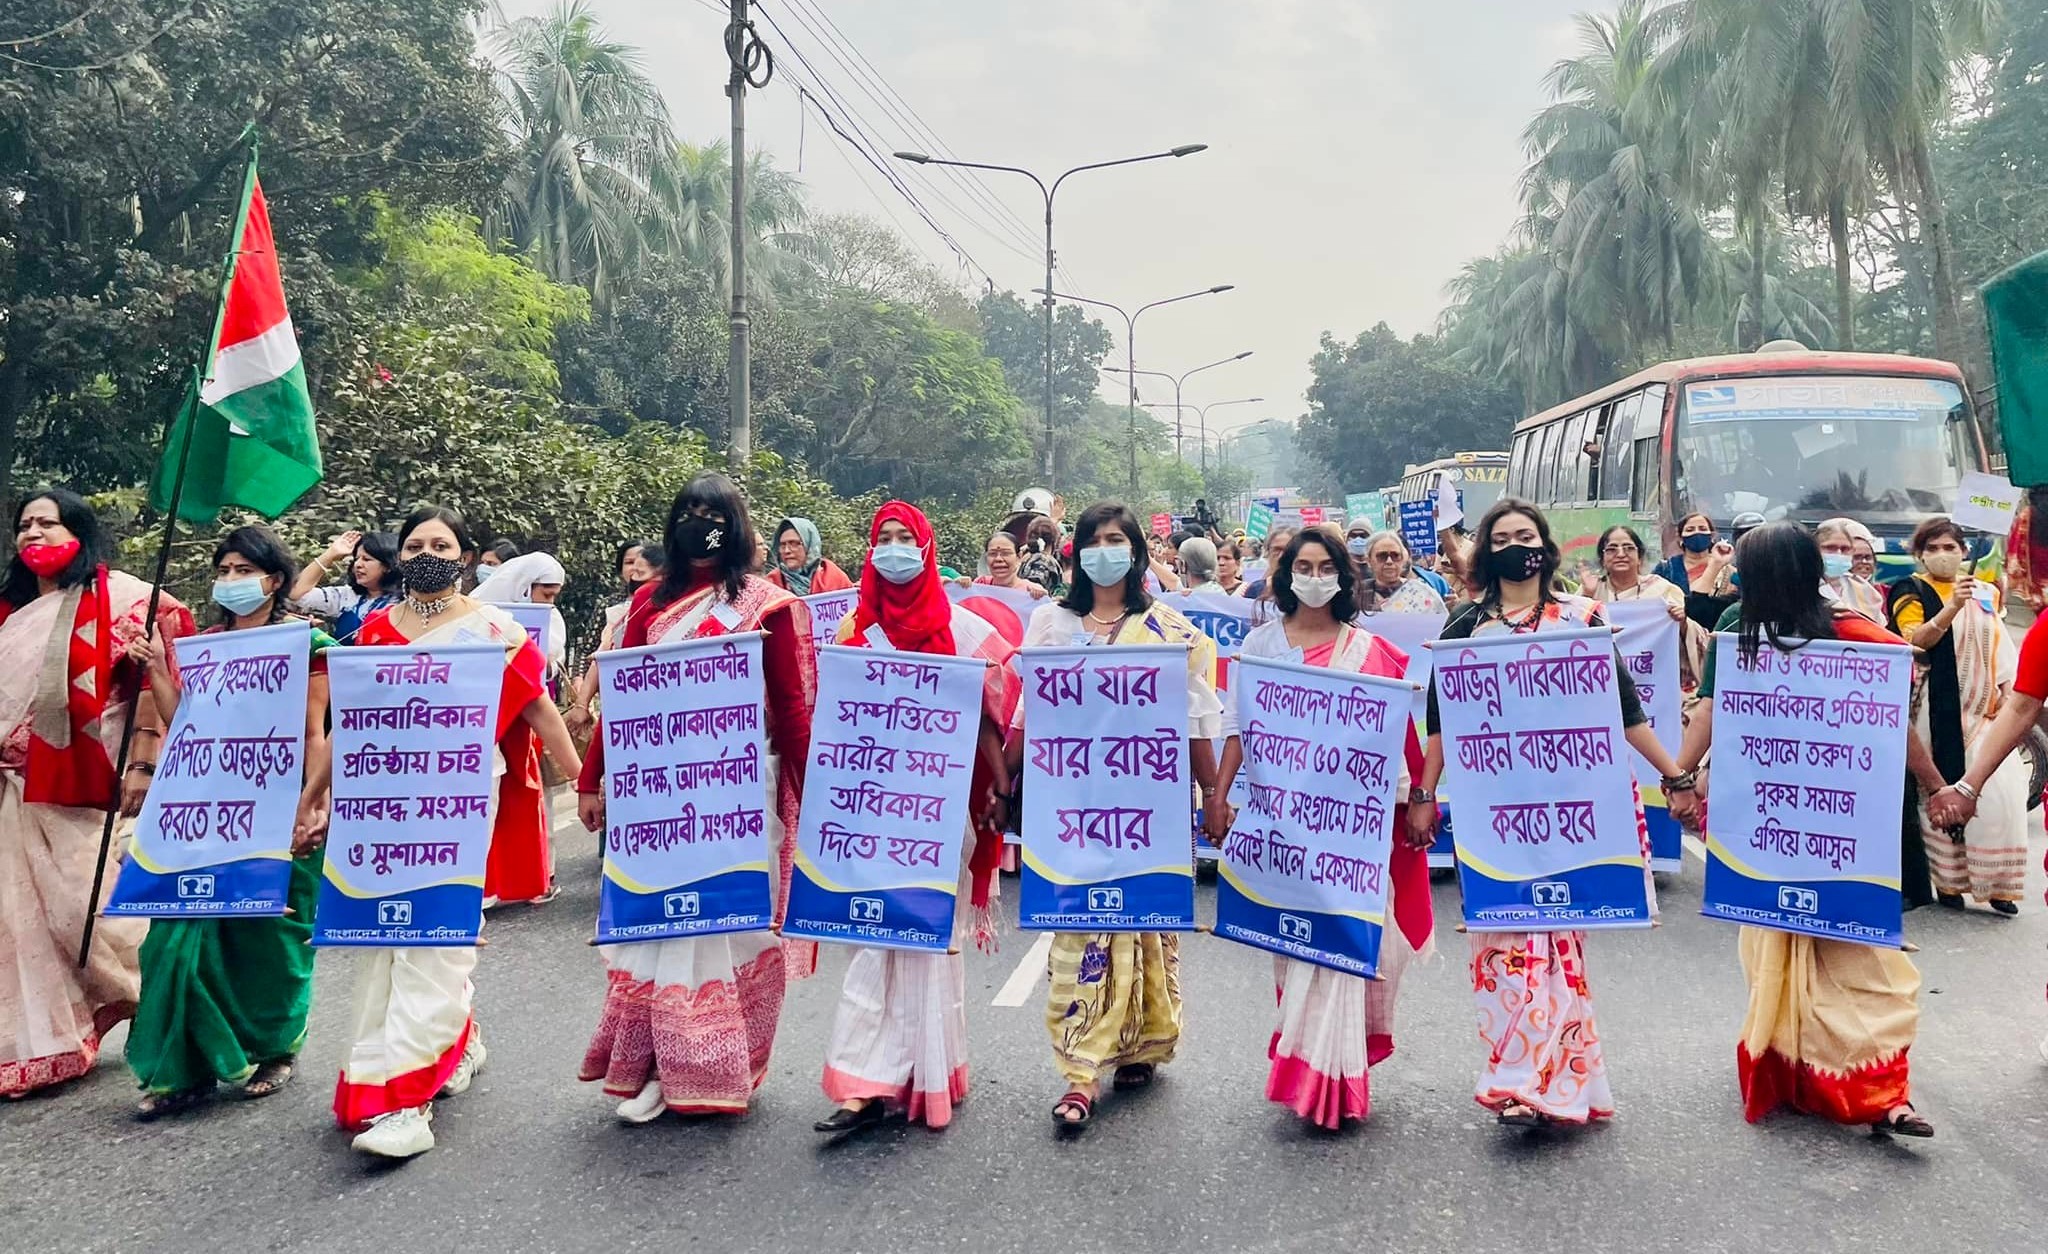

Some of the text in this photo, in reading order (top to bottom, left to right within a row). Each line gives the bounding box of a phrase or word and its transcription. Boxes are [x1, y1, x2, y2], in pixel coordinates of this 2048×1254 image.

[215, 654, 291, 707] গৃহশ্রমকে
[375, 653, 452, 686] নারীর
[613, 641, 749, 695] একবিংশ শতাব্দীর
[865, 659, 942, 695] সম্পদ
[1034, 657, 1160, 707] ধর্ম যার
[1440, 639, 1611, 717] অভিন্ন পারিবারিক
[1798, 647, 1890, 684] কন্যাশিশুর
[340, 697, 488, 731] মানবাধিকার
[609, 702, 758, 751] চ্যালেঞ্জ মোকাবেলায়
[837, 697, 960, 734] সম্পত্তিতে
[1255, 679, 1388, 733] বাংলাদেশ মহিলা
[1721, 685, 1901, 729] মানবাধিকার প্রতিষ্ঠার
[219, 725, 298, 790] অন্তর্ভুক্ত
[343, 742, 482, 779] প্রতিষ্ঠায় চাই
[612, 742, 759, 799] চাই দক্ষ, আদর্শবাদী
[817, 735, 899, 773] নারীর
[1029, 727, 1180, 782] যার রাষ্ট্র
[1242, 720, 1310, 770] পরিষদের
[1345, 748, 1390, 795] বছর,
[1456, 722, 1613, 776] আইন বাস্তবায়ন
[1740, 734, 1872, 772] সংগ্রামে তরুণ ও
[159, 800, 256, 843] করতে হবে
[333, 794, 489, 822] দায়বদ্ধ সংসদ
[829, 780, 946, 823] অধিকার
[1290, 789, 1349, 835] সংগ্রামে
[1351, 795, 1386, 842] চলি
[1753, 781, 1856, 818] পুরুষ সমাজ
[609, 801, 764, 857] ও স্বেচ্ছাসেবী সংগঠক
[818, 821, 944, 868] দিতে হবে
[1056, 806, 1153, 850] সবার
[1489, 800, 1596, 845] করতে হবে
[1750, 817, 1856, 871] এগিয়ে আসুন
[348, 841, 460, 876] ও সুশাসন
[1268, 829, 1307, 881] মিলে
[1310, 851, 1383, 896] একসাথে
[609, 914, 758, 937] বাংলাদেশ মহিলা পরিষদ
[795, 918, 938, 944] বাংলাদেশ মহিলা পরিষদ
[1030, 914, 1181, 925] বাংলাদেশ মহিলা পরিষদ
[1475, 906, 1636, 921] বাংলাদেশ মহিলা পরিষদ
